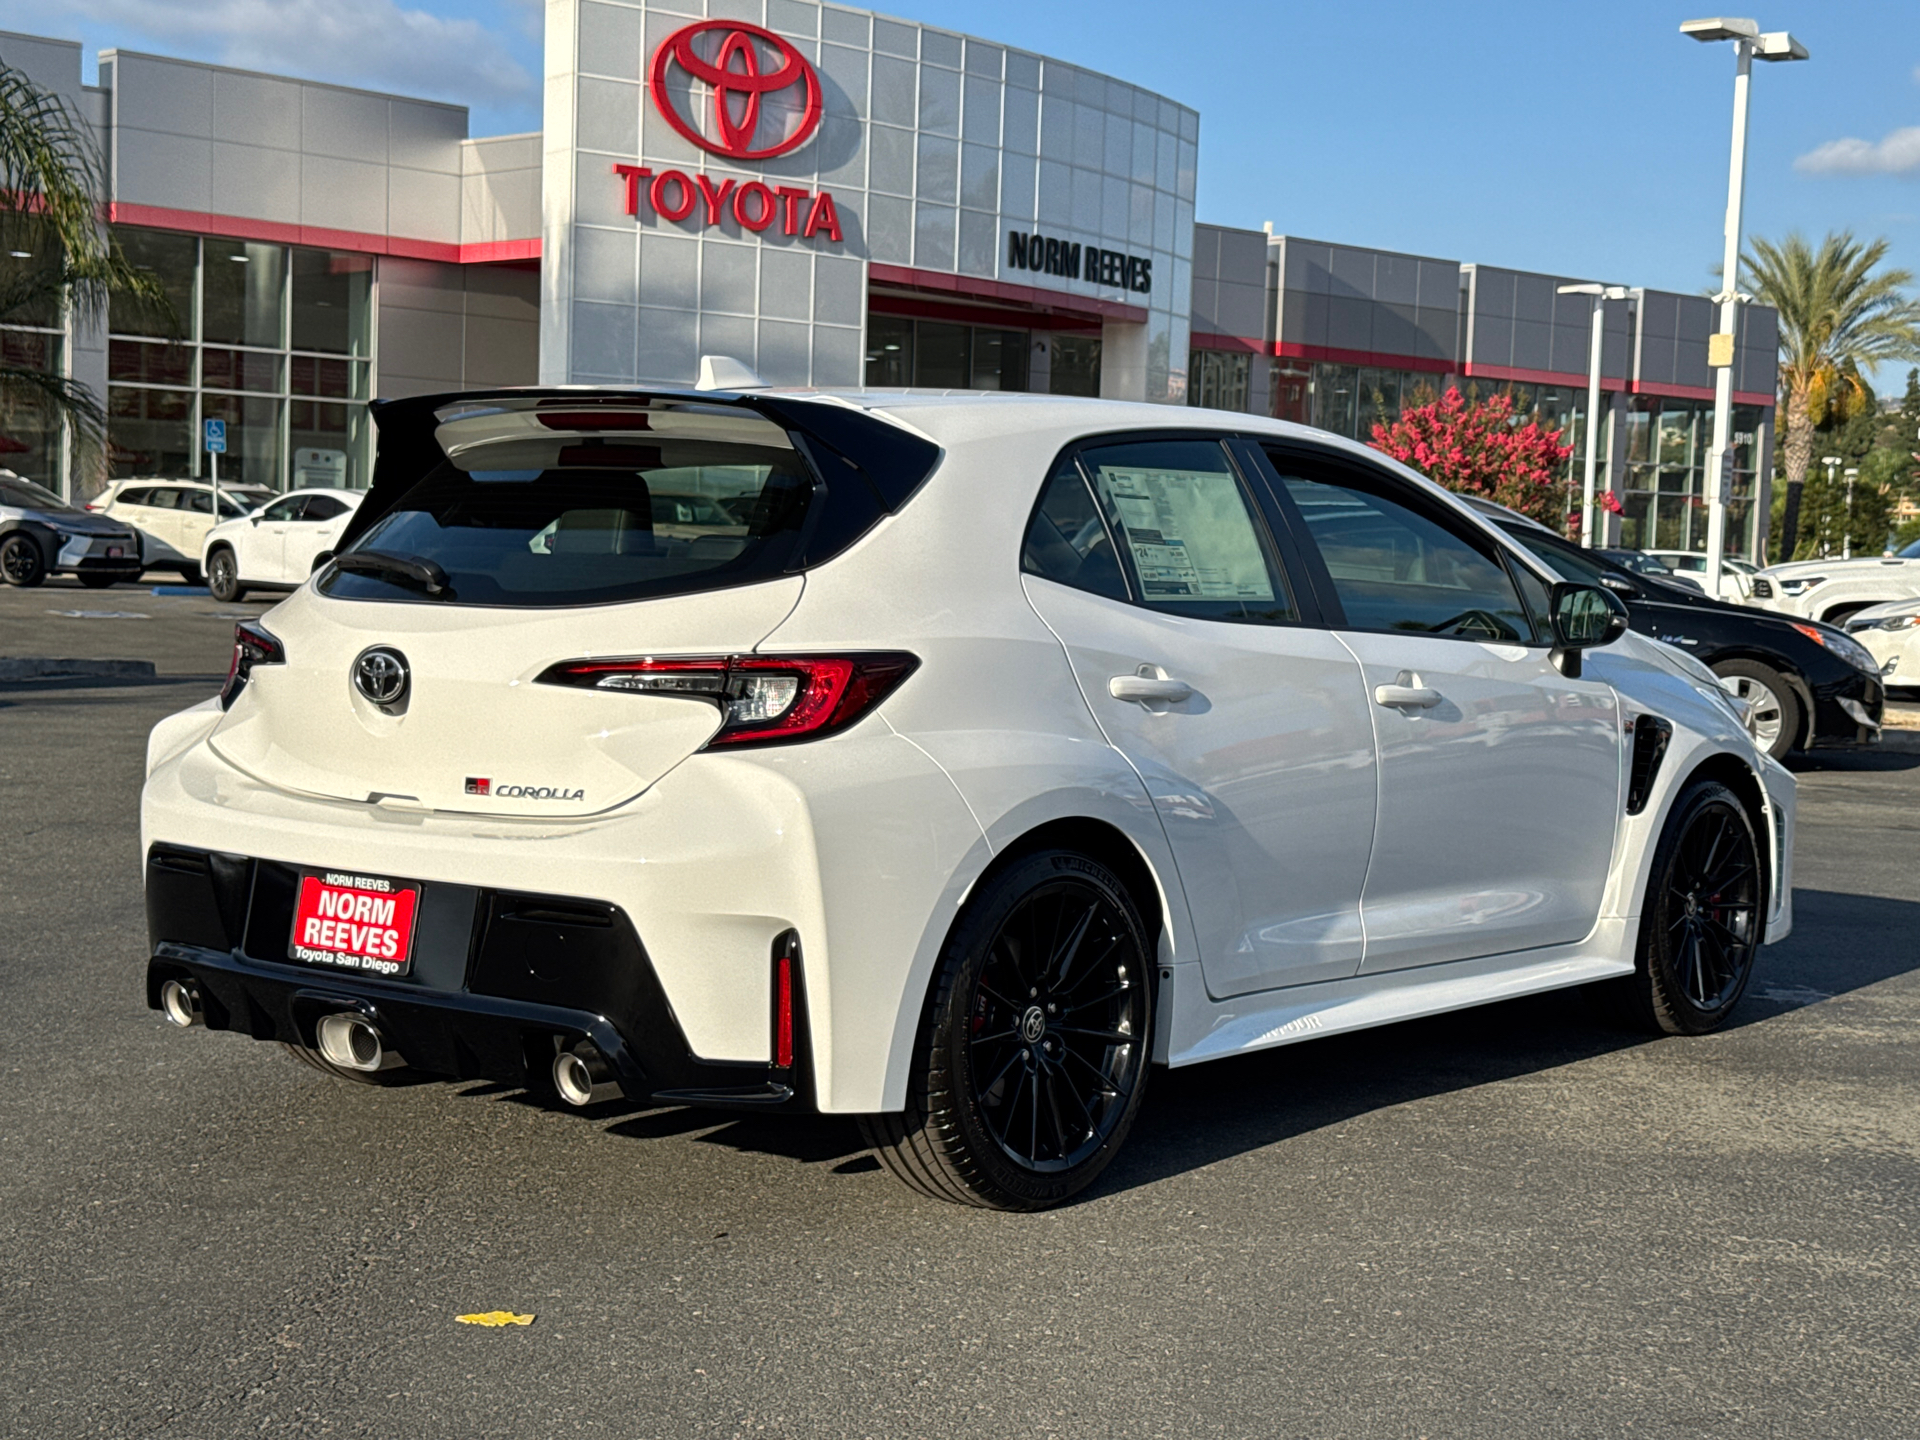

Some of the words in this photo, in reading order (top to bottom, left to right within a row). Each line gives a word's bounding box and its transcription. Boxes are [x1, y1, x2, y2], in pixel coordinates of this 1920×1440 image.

[612, 163, 844, 242] TOYOTA
[1008, 231, 1081, 279] NORM
[1084, 246, 1152, 294] REEVES
[466, 784, 489, 795] GR
[496, 785, 585, 801] COROLLA
[326, 873, 353, 887] NORM
[355, 877, 390, 892] REEVES
[1067, 858, 1121, 896] MICHELIN
[317, 890, 396, 926] NORM
[303, 917, 399, 957] REEVES
[295, 946, 334, 963] Toyota
[336, 952, 360, 967] San
[362, 957, 399, 974] Diego
